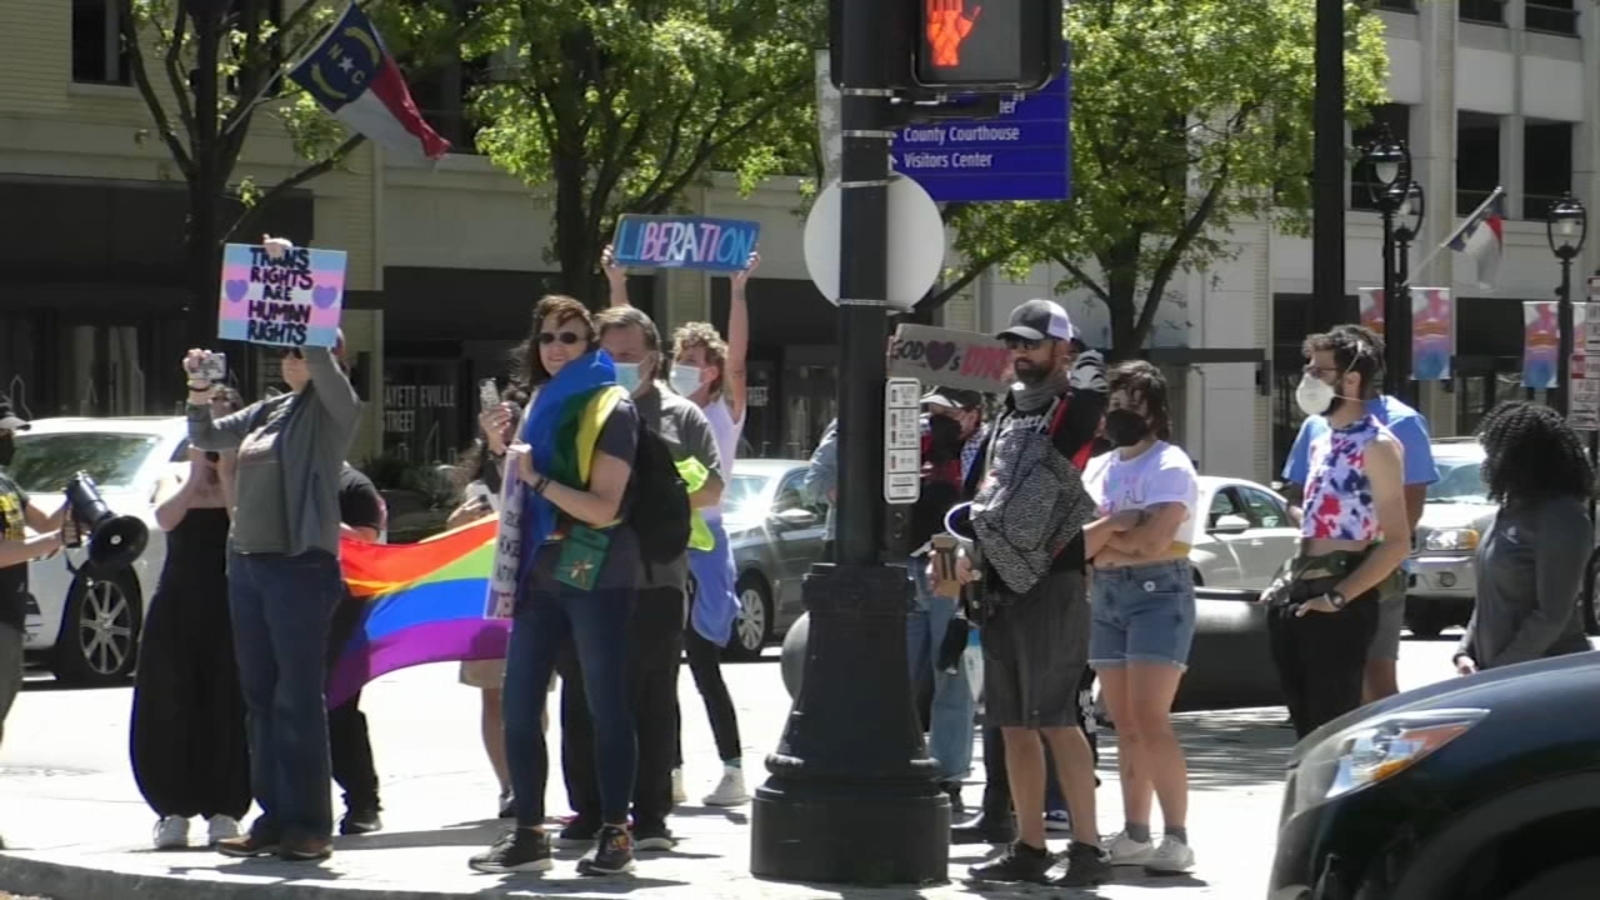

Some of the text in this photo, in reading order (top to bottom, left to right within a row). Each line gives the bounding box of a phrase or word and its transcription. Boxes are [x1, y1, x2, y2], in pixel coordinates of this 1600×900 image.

[903, 125, 1020, 145] County Courthouse
[904, 152, 993, 168] Visitors Center
[617, 220, 756, 266] LIBERATION
[250, 266, 313, 290] RIGHTS
[262, 285, 293, 301] ARE
[248, 299, 311, 324] HUMAN
[247, 320, 307, 345] RIGHTS
[891, 339, 926, 361] GOD
